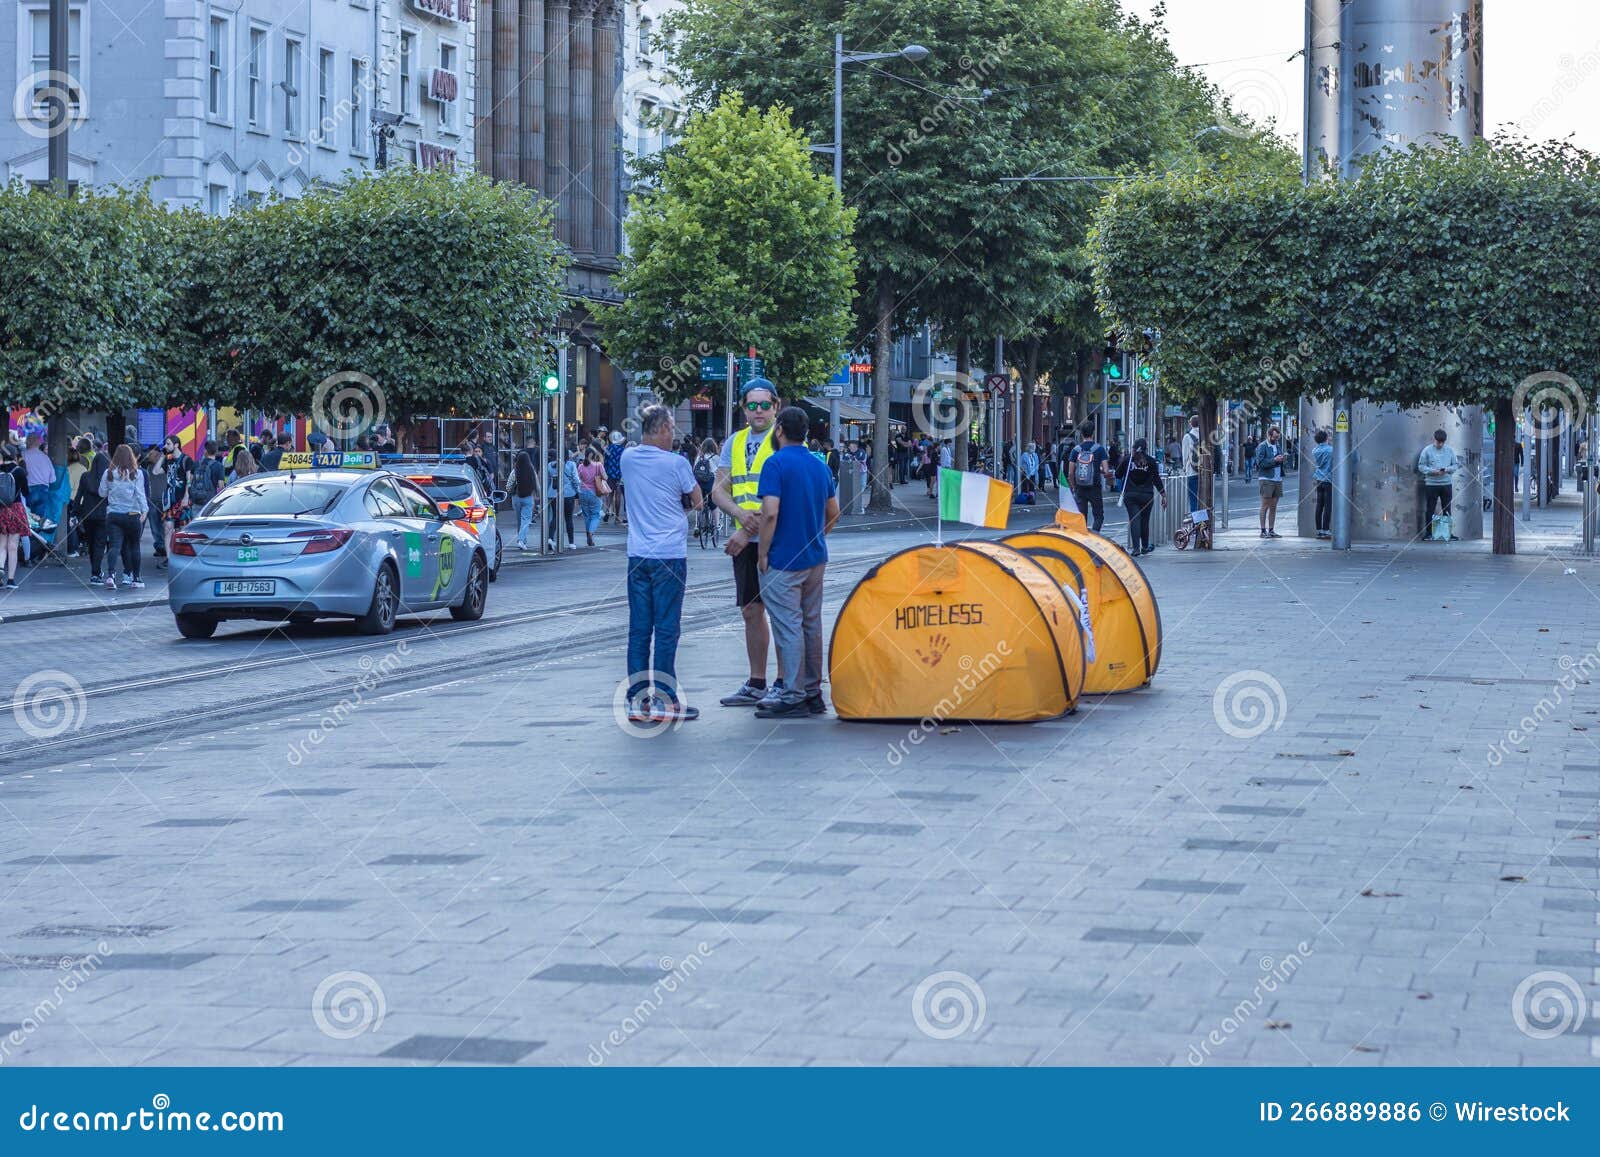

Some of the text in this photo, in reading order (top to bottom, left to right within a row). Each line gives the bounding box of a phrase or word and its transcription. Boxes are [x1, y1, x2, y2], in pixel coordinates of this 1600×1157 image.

[315, 453, 341, 465] TAXI
[344, 454, 362, 464] Bolt
[364, 454, 372, 464] D
[238, 549, 258, 560] Bolt
[408, 546, 420, 566] Bolt
[440, 552, 453, 570] TAXI
[895, 603, 983, 630] HOMELESS
